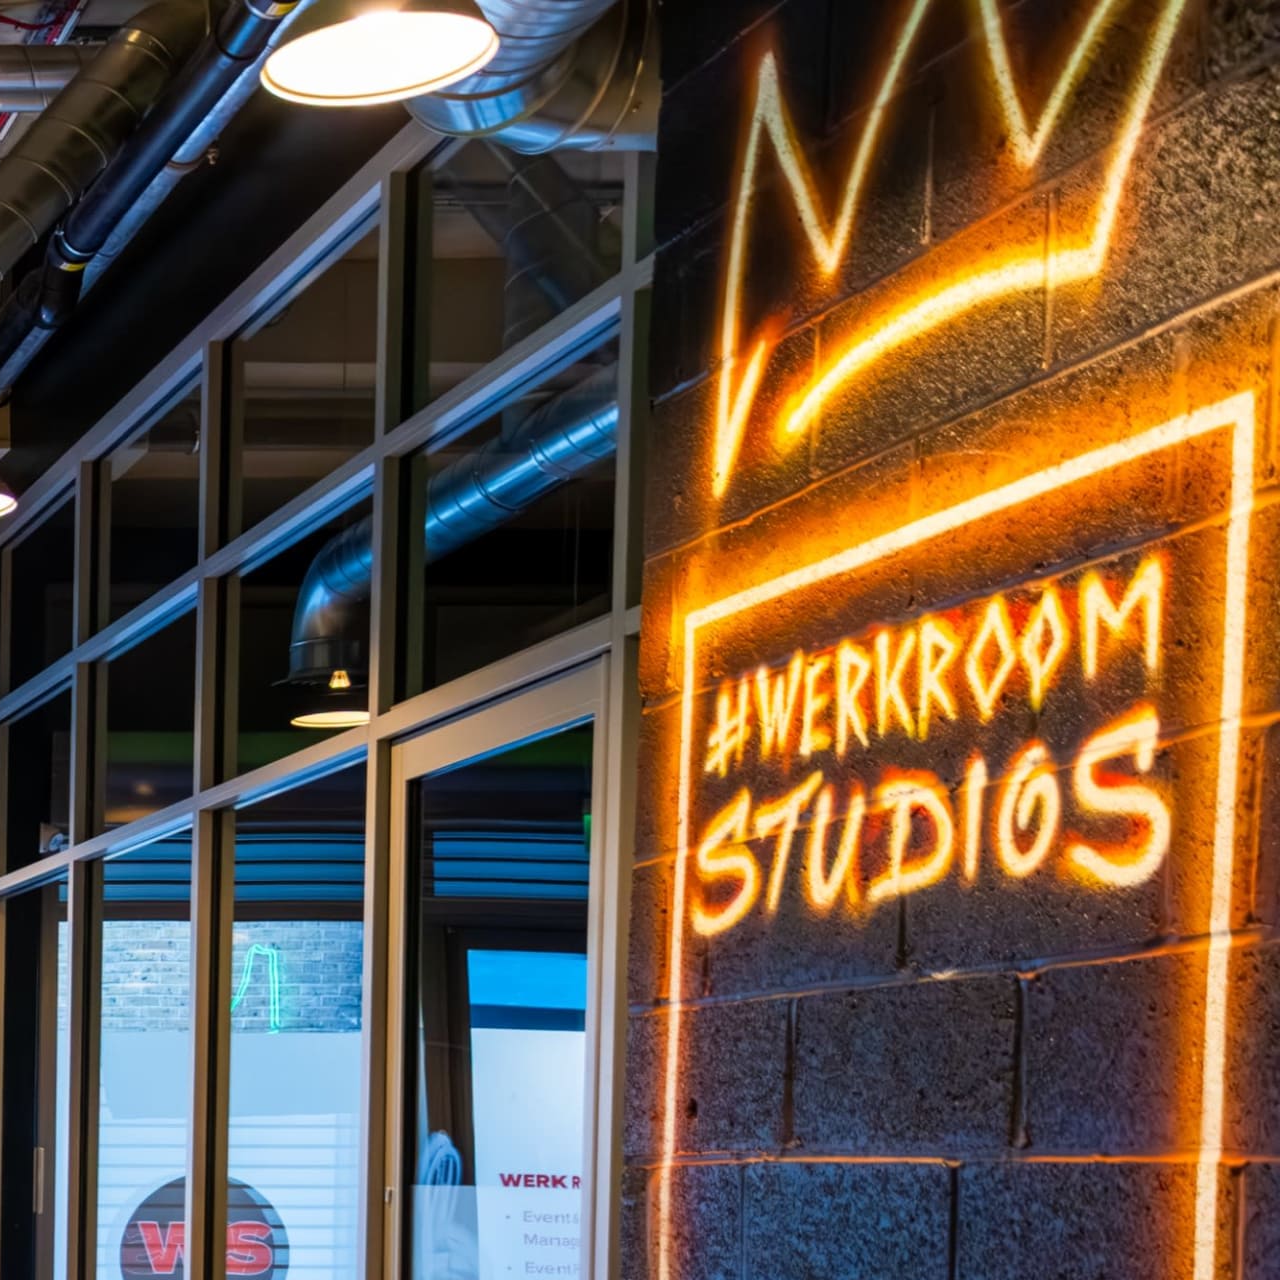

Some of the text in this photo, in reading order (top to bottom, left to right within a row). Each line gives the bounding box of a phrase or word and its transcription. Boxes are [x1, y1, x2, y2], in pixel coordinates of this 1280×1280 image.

[703, 551, 1170, 777] #WERKROOM
[690, 704, 1173, 938] STUDIOS
[499, 1172, 568, 1189] WERK
